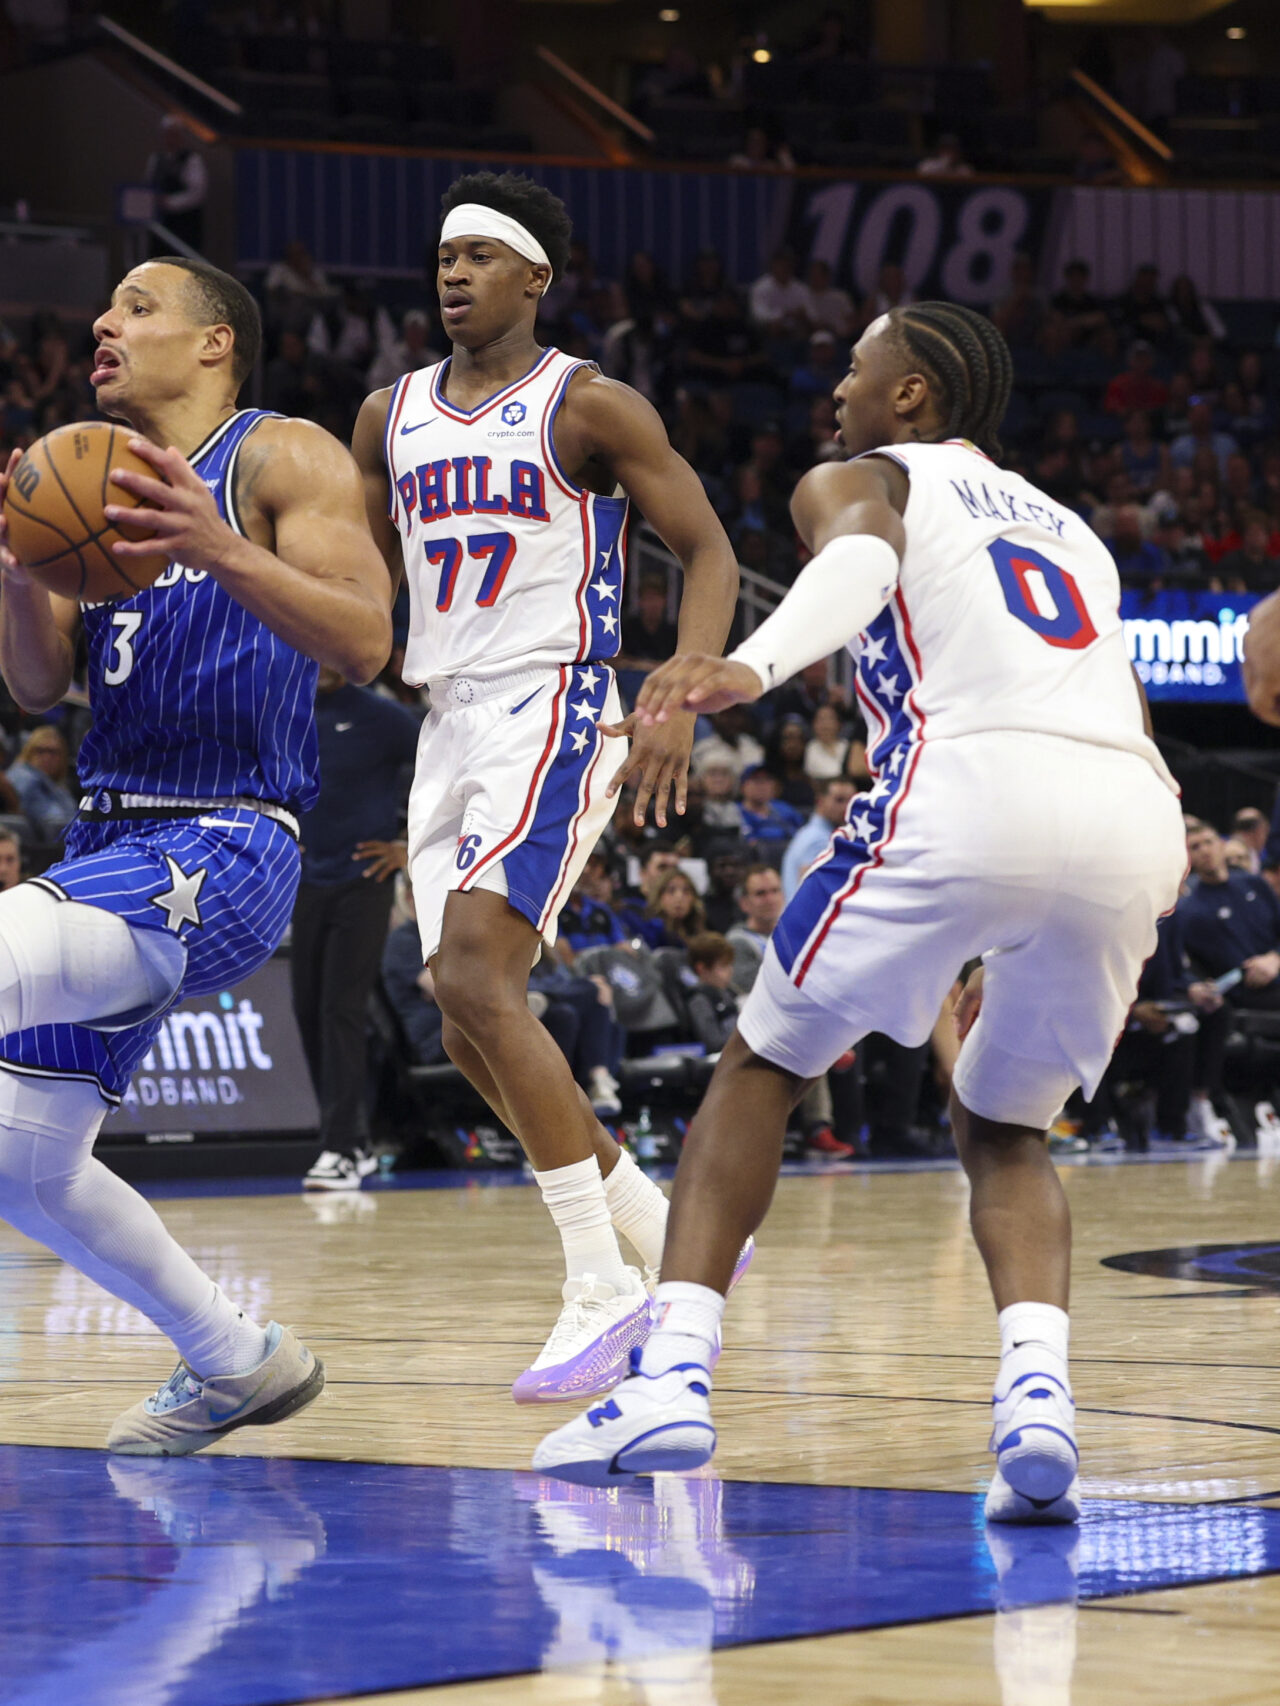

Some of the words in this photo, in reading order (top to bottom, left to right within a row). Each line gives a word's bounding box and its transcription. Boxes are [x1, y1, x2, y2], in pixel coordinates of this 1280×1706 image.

[806, 182, 1029, 304] 108
[487, 430, 535, 439] crypto.com
[396, 455, 551, 538] PHILA
[949, 479, 1066, 540] MAXEY
[423, 532, 517, 613] 77
[986, 536, 1100, 650] 0
[104, 611, 143, 686] 3
